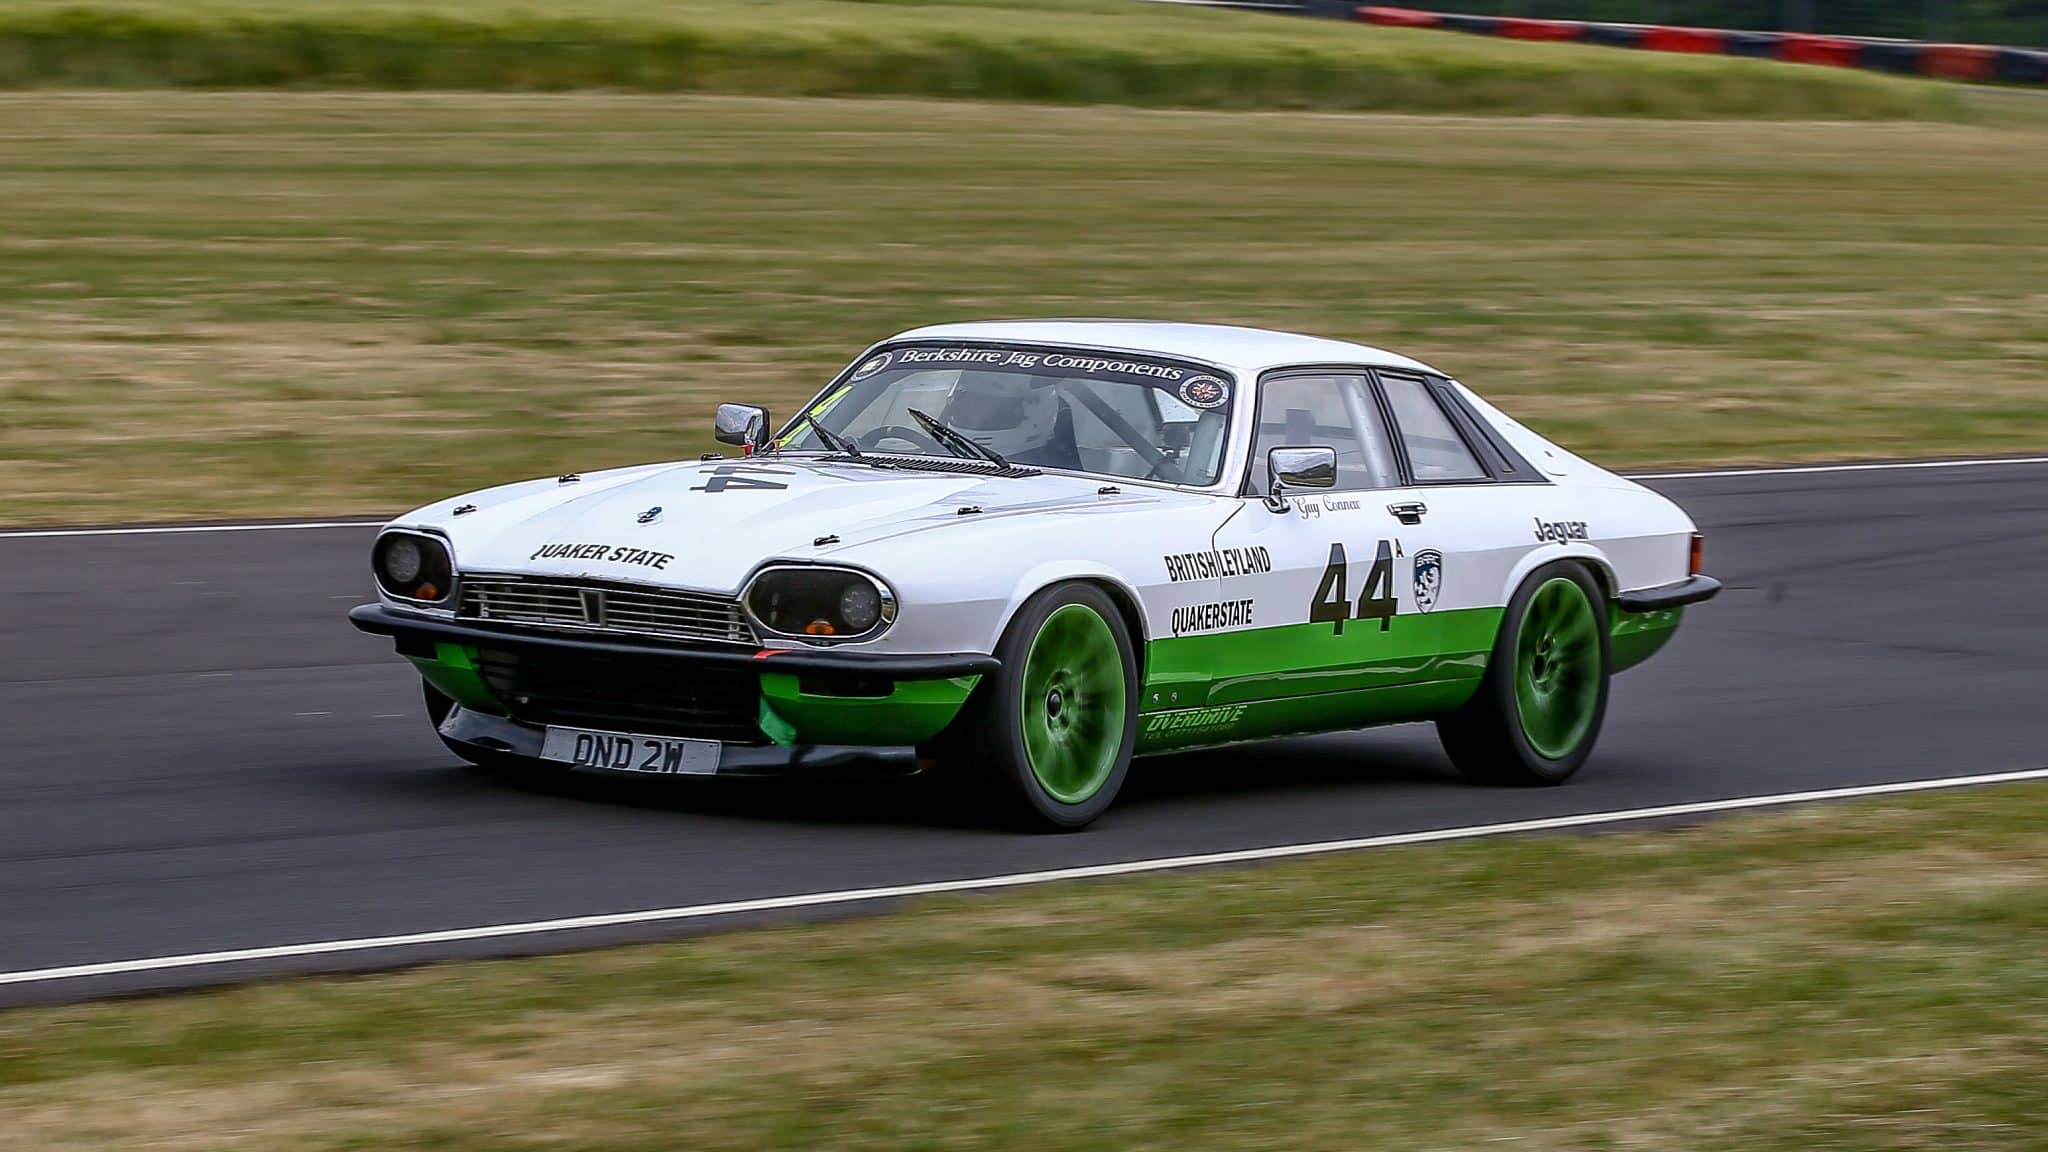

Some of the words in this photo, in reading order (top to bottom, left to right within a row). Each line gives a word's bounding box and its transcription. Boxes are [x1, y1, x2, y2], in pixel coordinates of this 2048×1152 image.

[898, 348, 1001, 364] Berkshire
[999, 351, 1042, 368] Jag
[1042, 353, 1184, 380] Components
[1292, 496, 1321, 520] Guy
[1533, 516, 1589, 546] Jaguar
[607, 547, 676, 571] STATE
[1163, 550, 1220, 582] BRITISH
[1220, 545, 1272, 577] LEYLAND
[1171, 599, 1254, 638] QUAKERSTATE
[1146, 705, 1248, 732] OVERDRIVE
[639, 740, 685, 774] 2W
